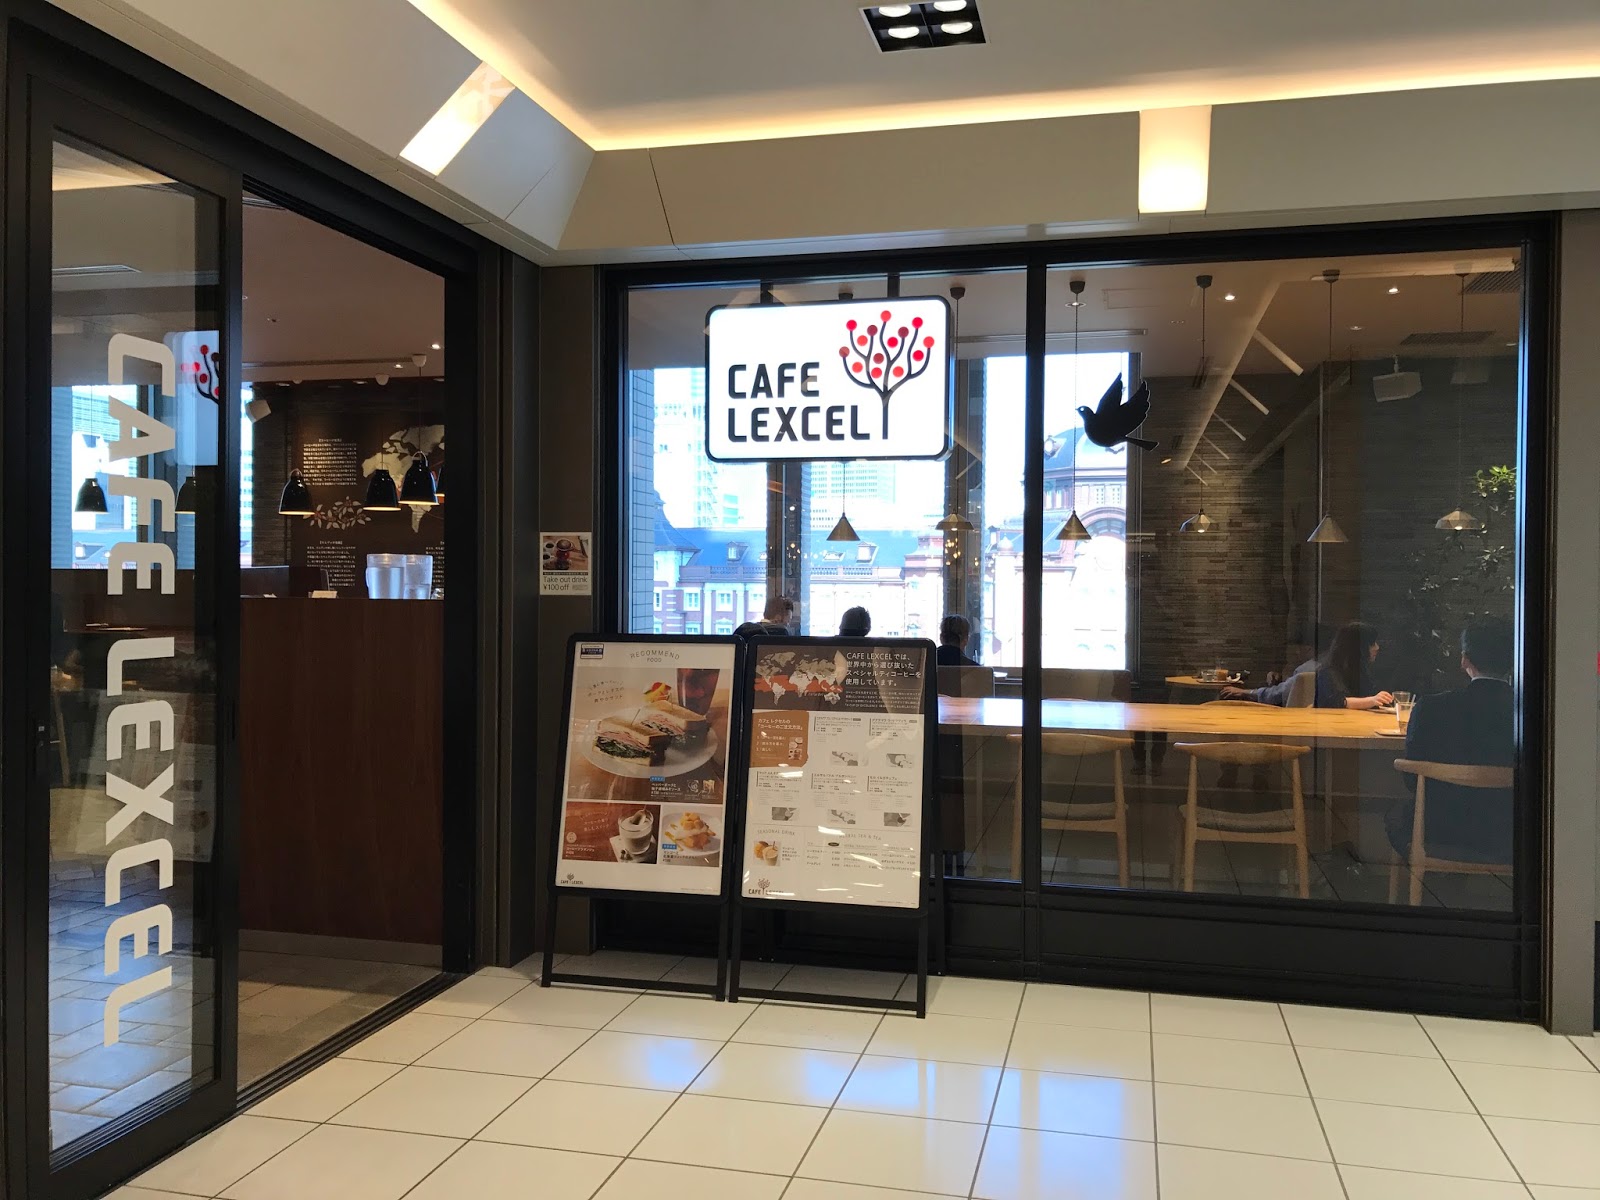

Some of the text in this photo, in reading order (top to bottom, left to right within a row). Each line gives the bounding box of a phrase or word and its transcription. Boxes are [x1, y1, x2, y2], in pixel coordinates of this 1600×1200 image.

[728, 362, 820, 399] CAFE
[728, 405, 871, 442] LEXCEL
[630, 650, 680, 660] RECOMMEND
[846, 661, 915, 670] 世界中から選び抜いた
[846, 670, 922, 679] スペシャルティコーヒーを
[845, 678, 897, 687] 使用しています。
[104, 333, 176, 1048] CAFE LEXCEL
